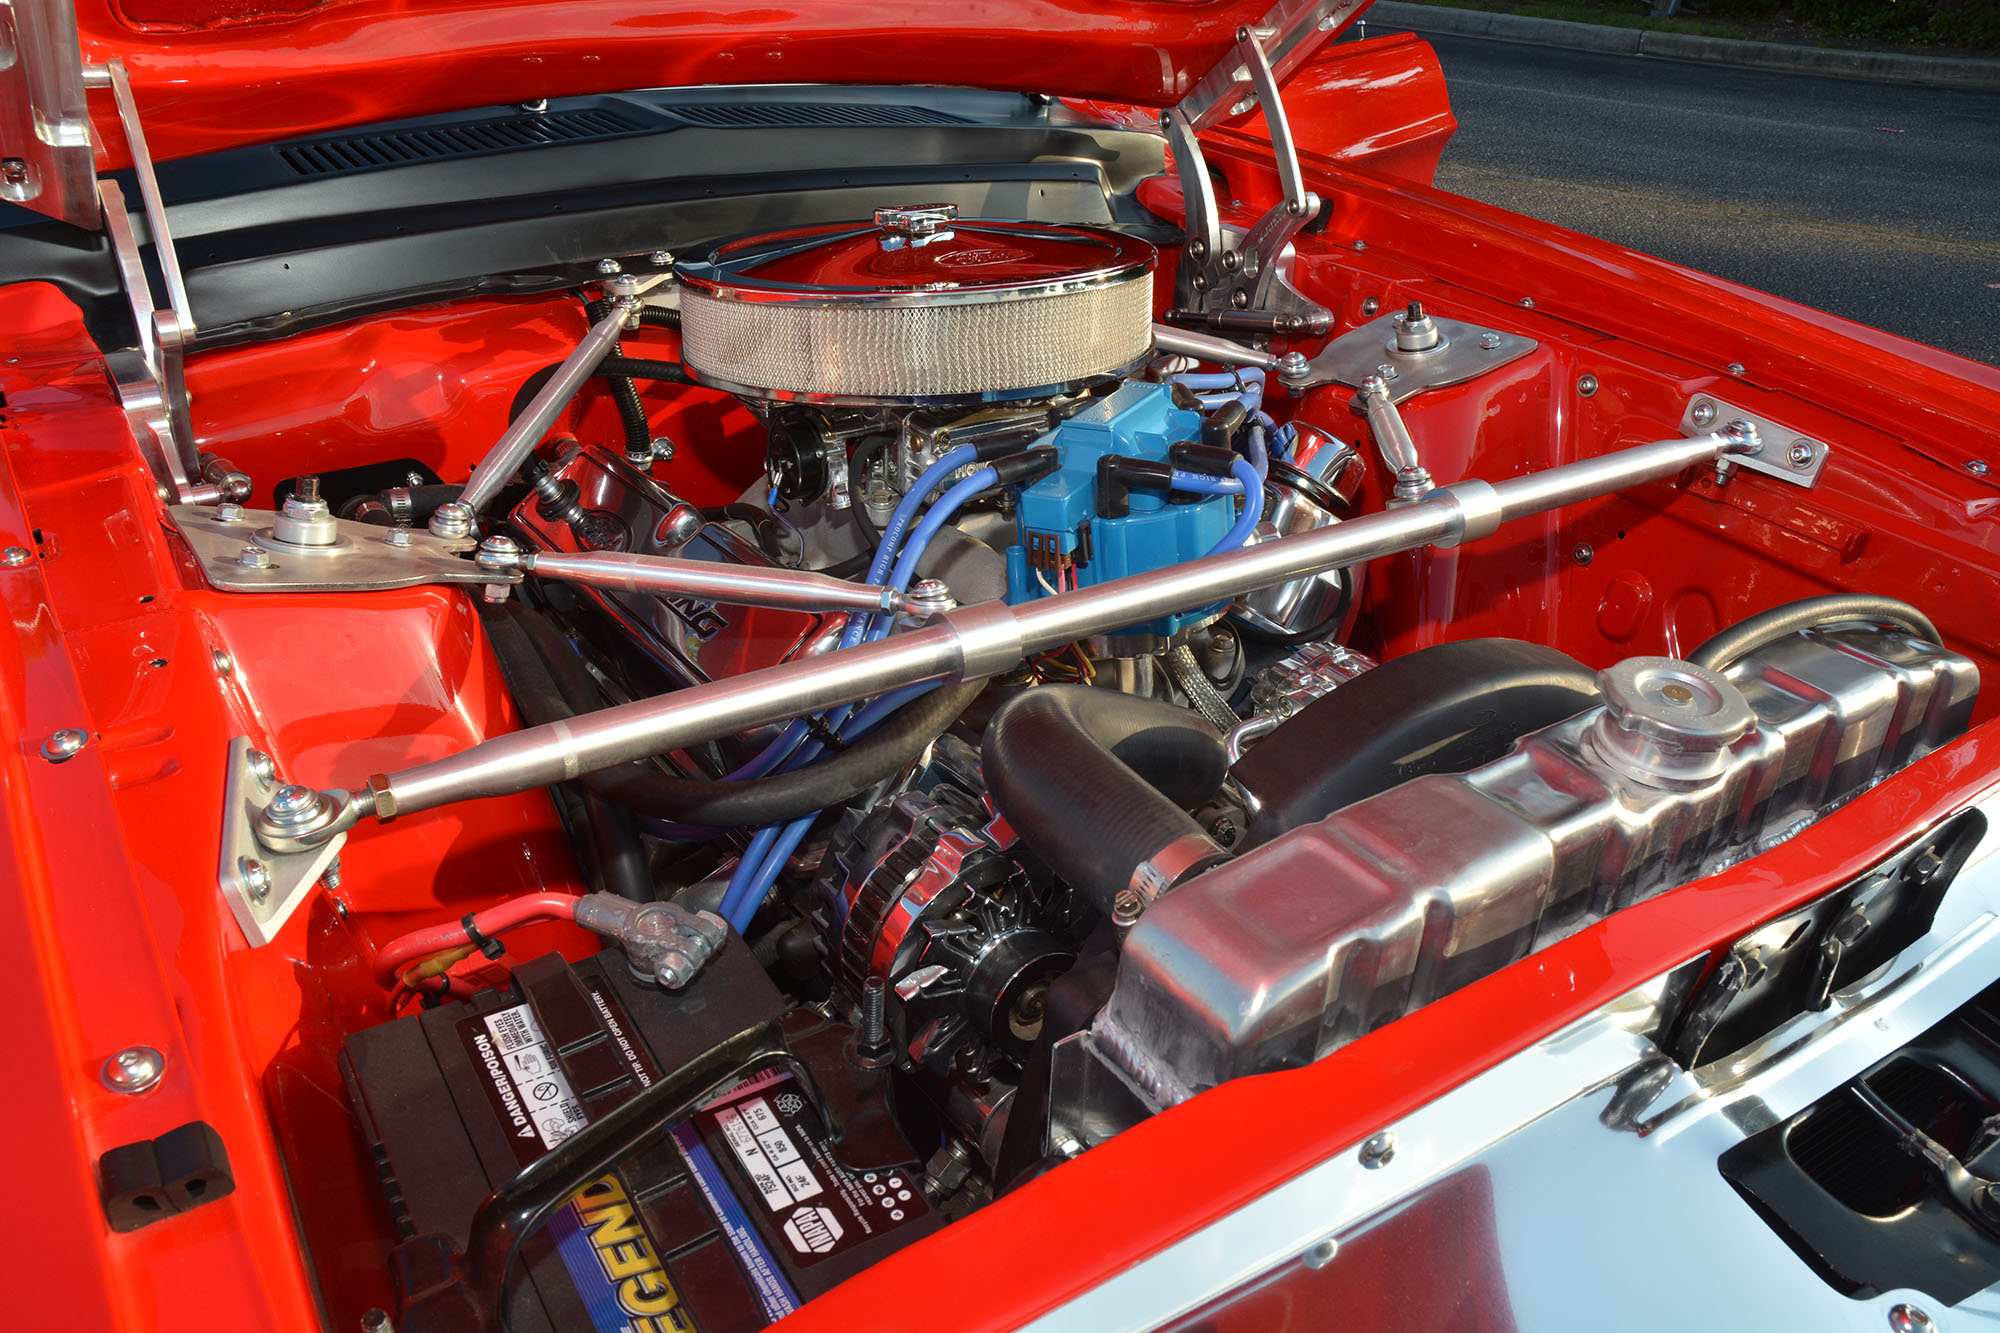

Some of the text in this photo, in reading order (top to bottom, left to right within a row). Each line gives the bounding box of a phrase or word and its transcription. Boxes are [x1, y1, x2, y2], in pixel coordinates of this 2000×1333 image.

[886, 517, 904, 552] PROCOMP
[877, 554, 889, 575] HIGH
[494, 1019, 515, 1050] FLUSH EYES
[501, 1012, 523, 1046] IMMEDIATELY
[510, 1009, 533, 1043] WITH WATER.
[591, 990, 651, 1086] NOT TIP. DO NOT OPEN BATTERY.
[474, 1034, 527, 1126] DANGER/POISON
[560, 1102, 576, 1123] SHIELD
[753, 1107, 766, 1120] 675
[745, 1147, 758, 1156] N
[774, 1139, 787, 1153] 850
[759, 1173, 777, 1193] 7524F
[795, 1174, 810, 1187] 24F
[794, 1208, 834, 1249] NAPA
[736, 1225, 759, 1257] HANDLING.
[753, 1256, 771, 1275] AFTER
[766, 1275, 784, 1297] HANDS
